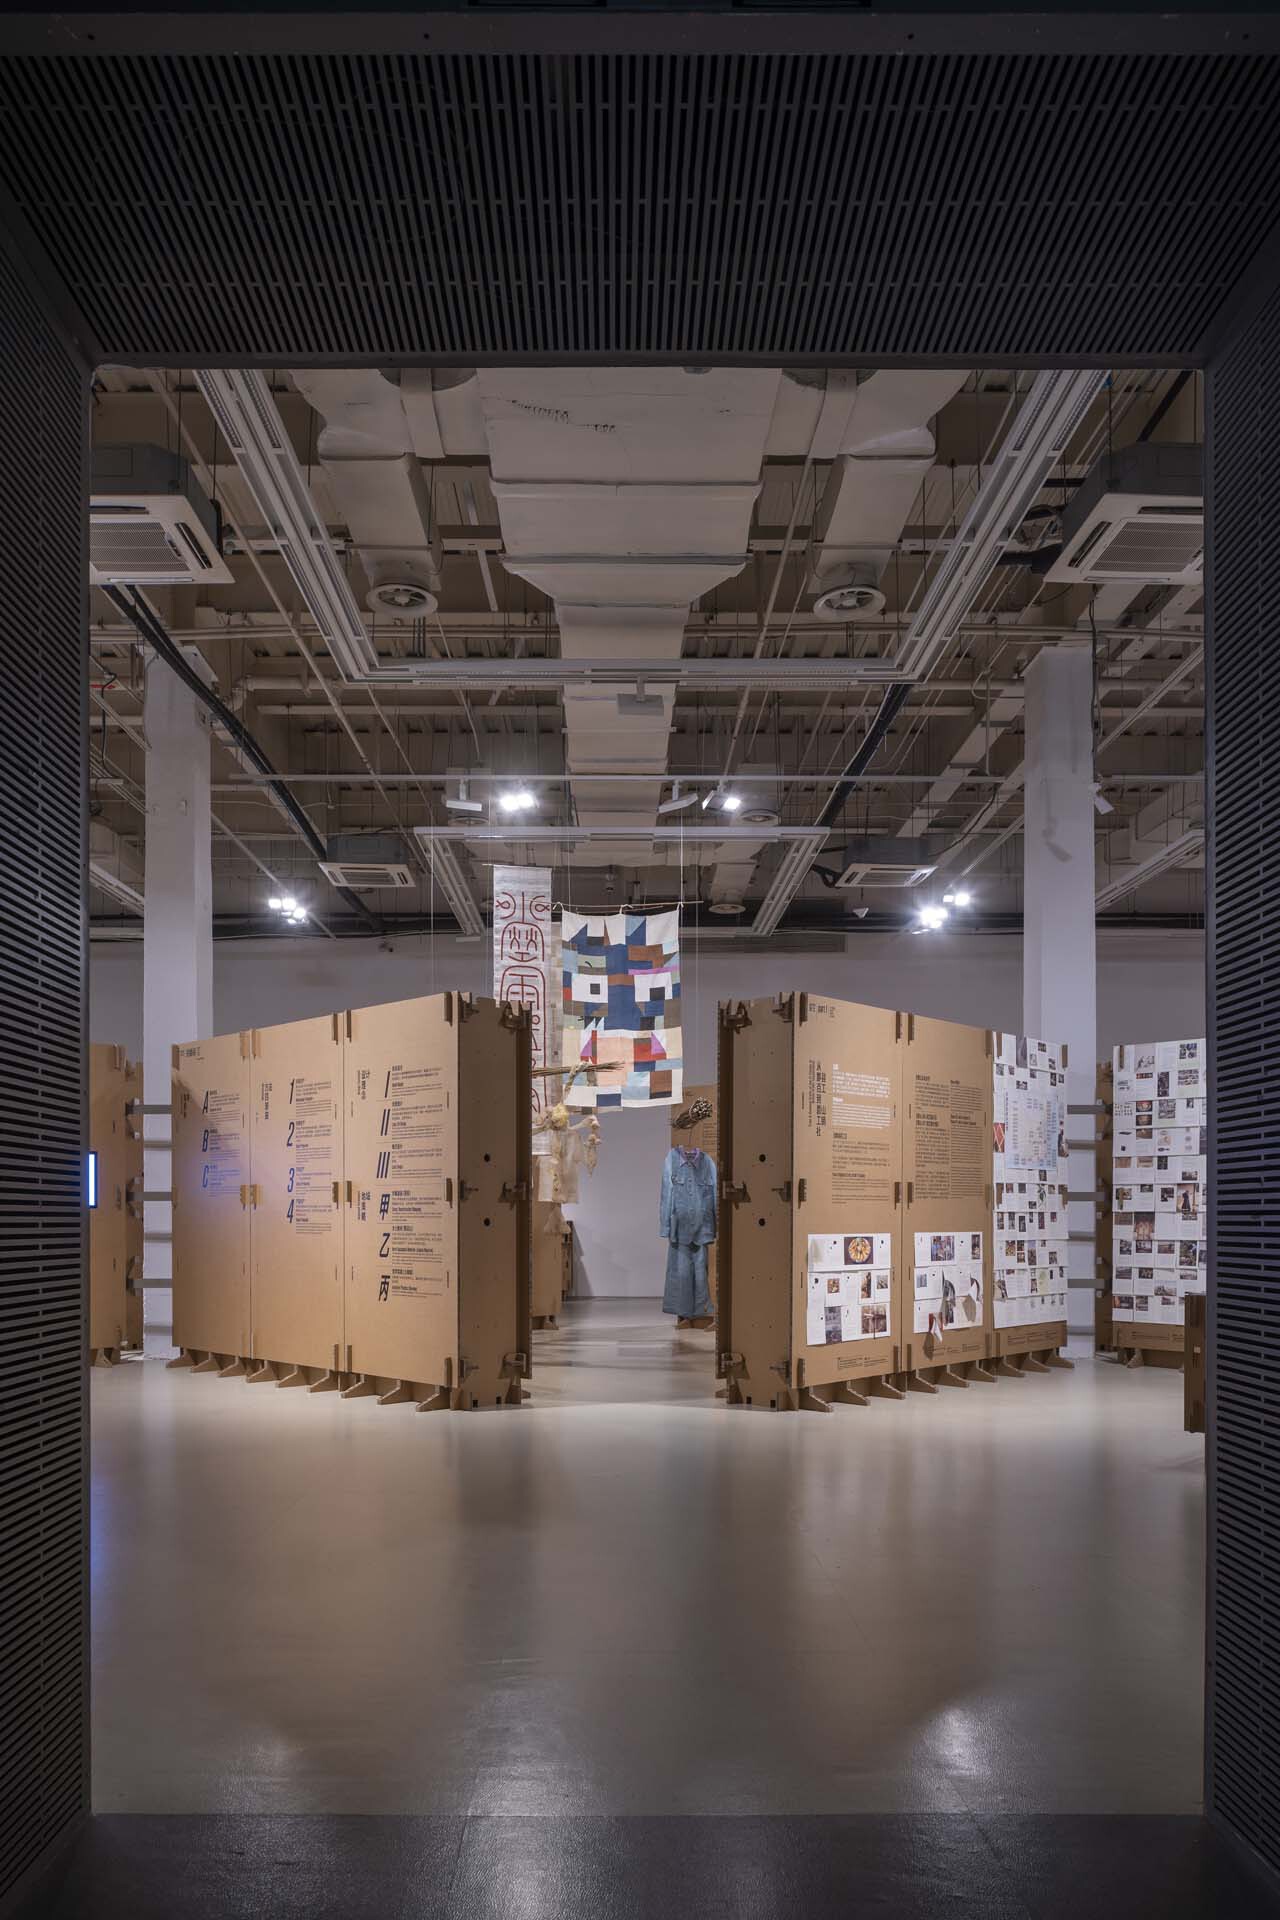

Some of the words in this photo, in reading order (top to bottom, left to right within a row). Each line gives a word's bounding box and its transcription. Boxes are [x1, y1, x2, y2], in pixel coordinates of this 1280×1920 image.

[202, 1090, 209, 1115] A
[290, 1078, 294, 1104] 1
[202, 1129, 209, 1152] B
[286, 1121, 294, 1147] 2
[202, 1164, 209, 1188] C
[287, 1167, 294, 1193] 3
[286, 1199, 294, 1224] 4
[379, 1193, 390, 1221] 甲
[378, 1274, 390, 1302] 丙
